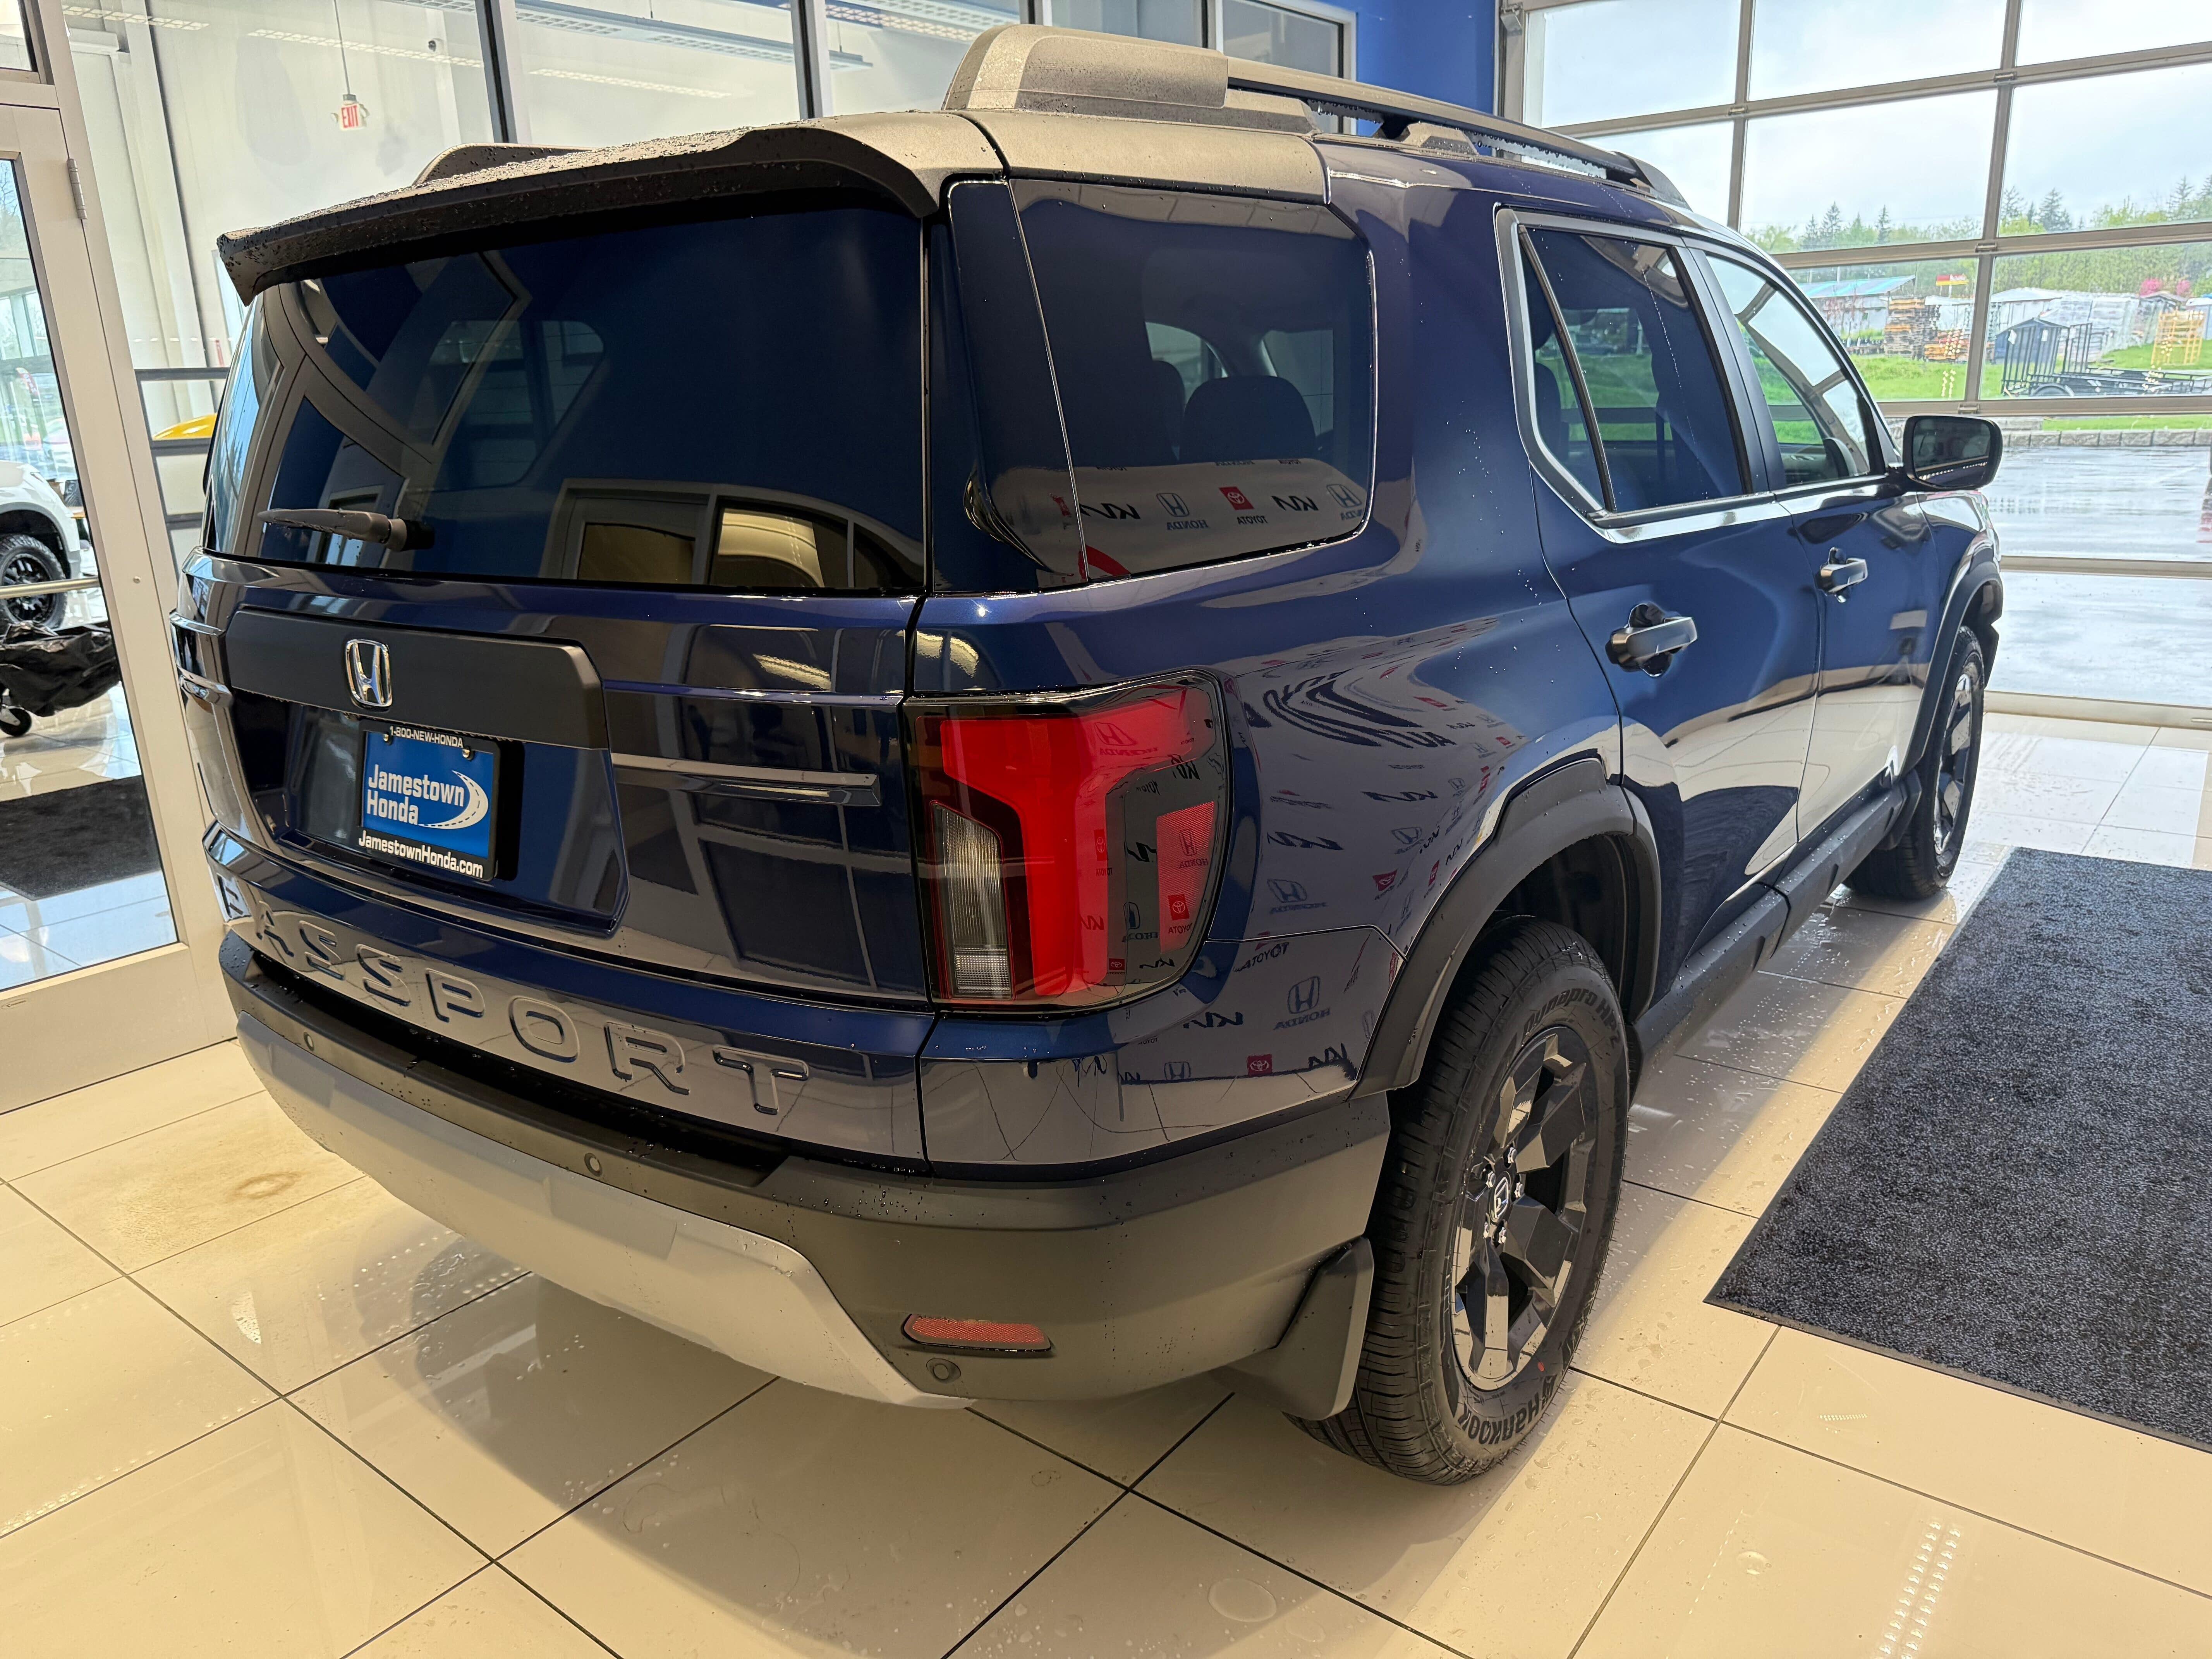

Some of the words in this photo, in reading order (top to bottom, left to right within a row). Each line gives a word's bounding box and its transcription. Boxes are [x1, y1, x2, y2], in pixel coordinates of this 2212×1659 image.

[340, 105, 359, 128] EXIT
[367, 789, 419, 826] Honda
[368, 764, 465, 807] Jamestown
[359, 830, 483, 878] JamestownHonda.com
[216, 872, 810, 1115] PASSPORT
[1458, 1392, 1540, 1446] Hankook
